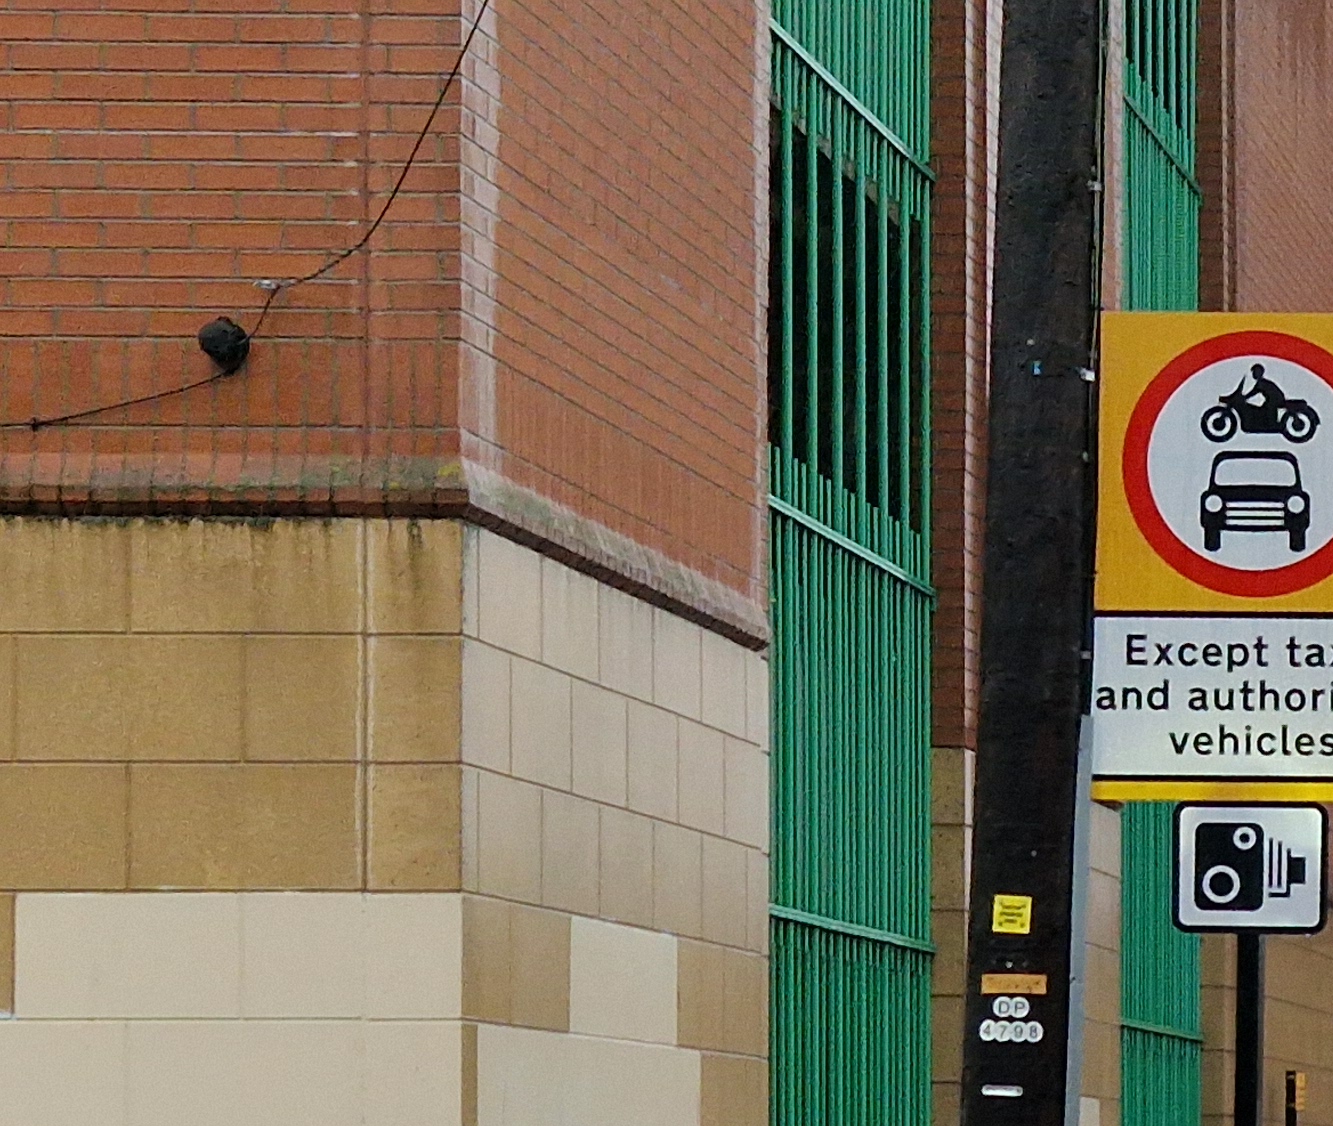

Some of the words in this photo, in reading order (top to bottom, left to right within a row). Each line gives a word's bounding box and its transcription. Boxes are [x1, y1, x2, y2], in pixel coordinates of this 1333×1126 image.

[1126, 634, 1268, 672] Except
[1096, 679, 1169, 711] and
[998, 1001, 1026, 1014] DP
[983, 1024, 1038, 1039] 4798
